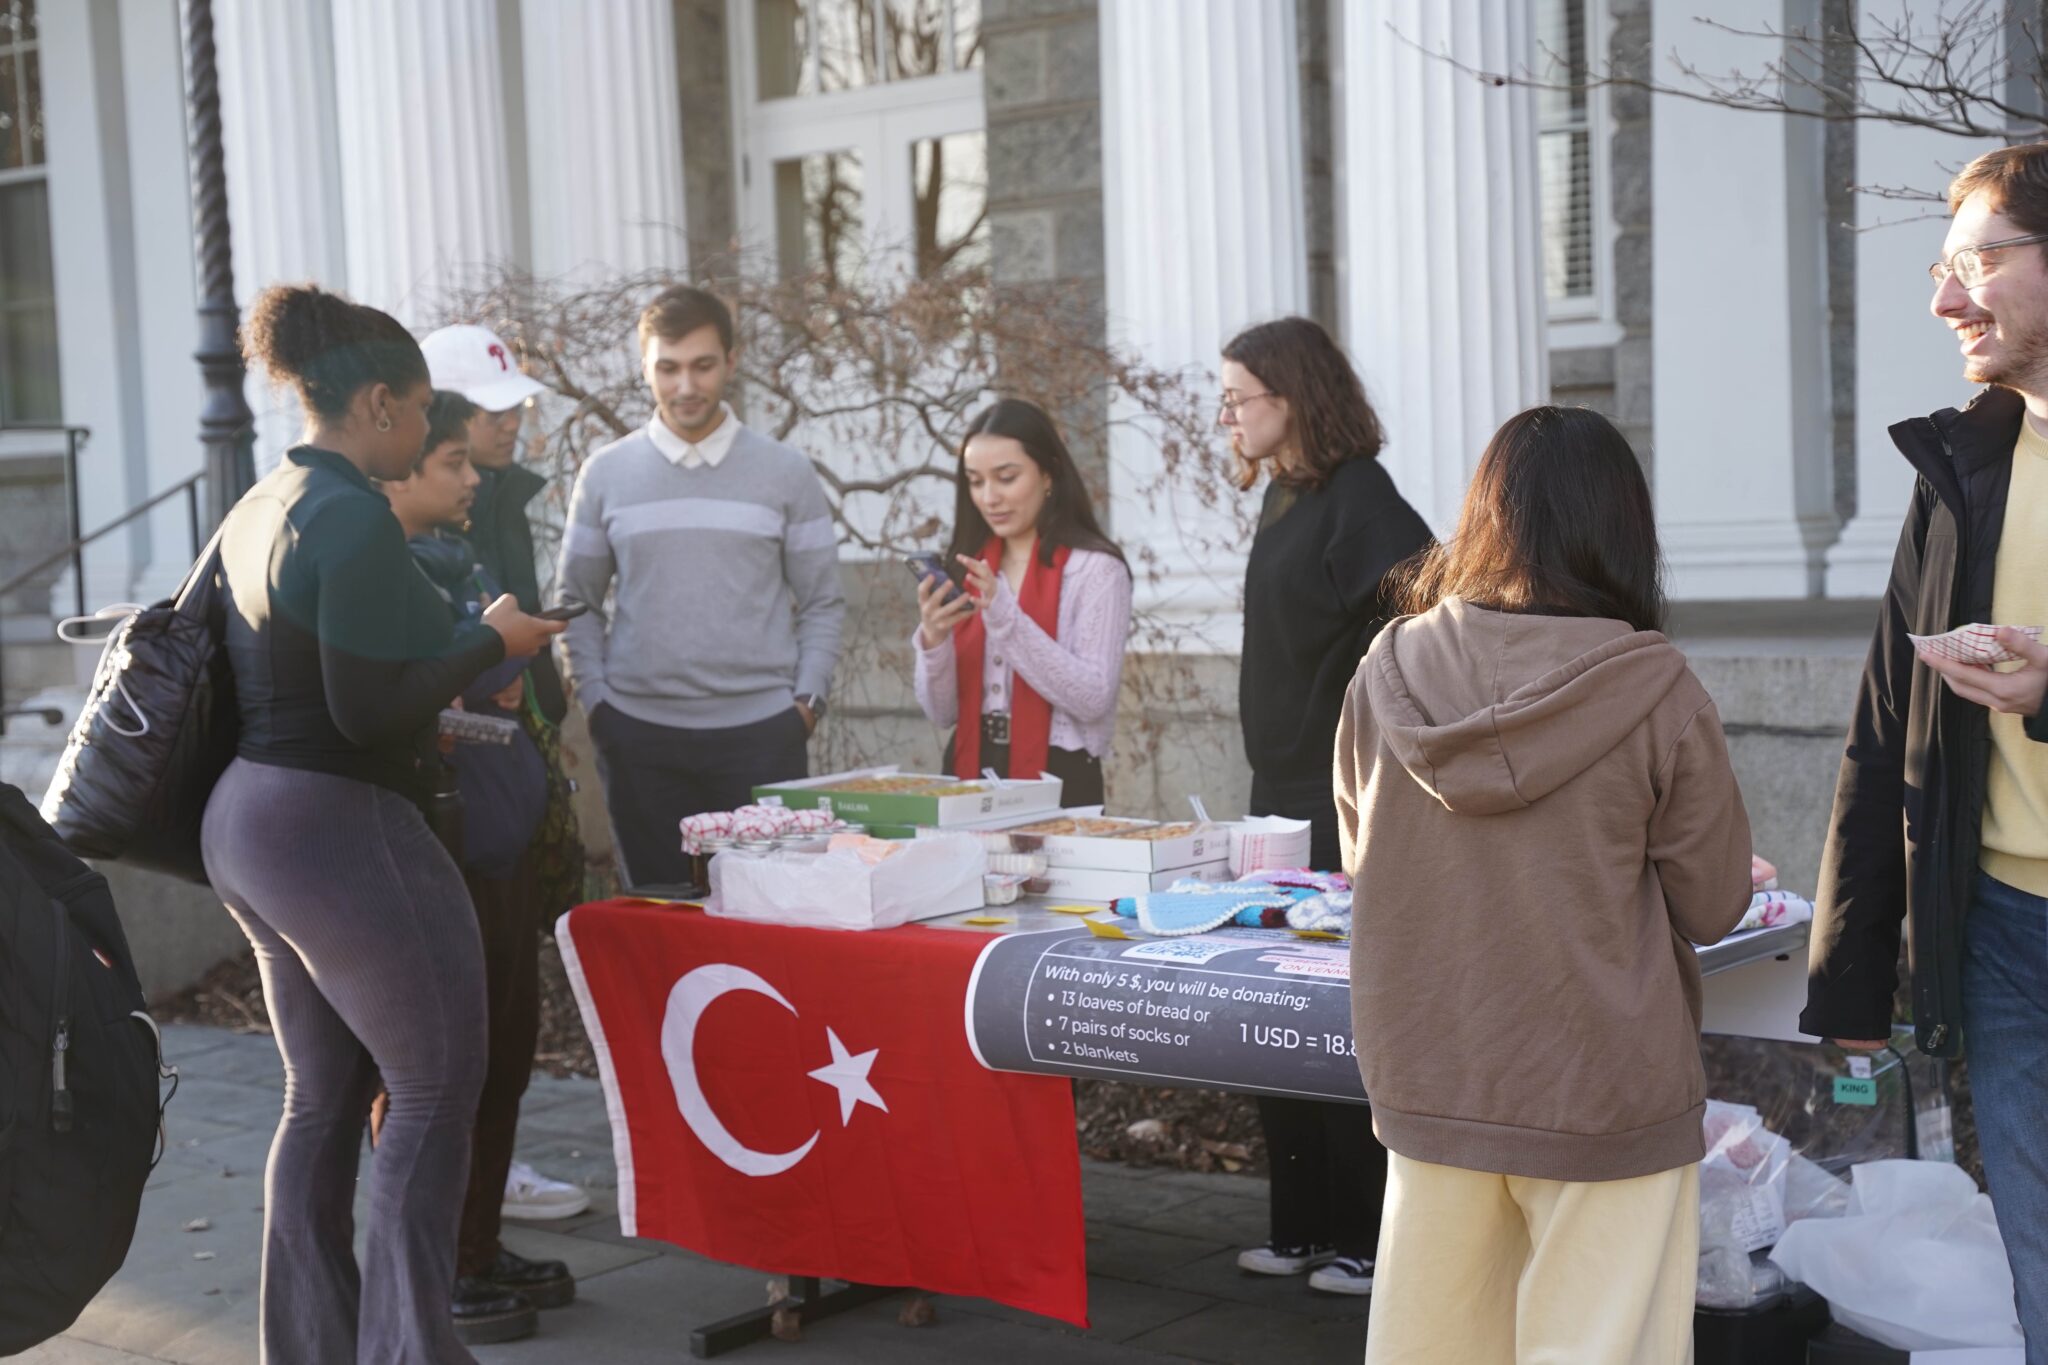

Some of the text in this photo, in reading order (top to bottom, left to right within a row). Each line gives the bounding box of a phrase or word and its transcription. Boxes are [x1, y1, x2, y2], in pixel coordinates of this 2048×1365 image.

[1045, 965, 1080, 981] With
[1082, 971, 1115, 989] only
[1116, 973, 1129, 987] 5
[1143, 979, 1175, 993] you
[1178, 981, 1207, 996] will
[1208, 983, 1229, 998] be
[1232, 986, 1311, 1011] donating:
[1062, 991, 1211, 1023] 13 loaves of bread or
[1058, 1015, 1190, 1047] 7 pairs of socks or
[1239, 1023, 1248, 1043] 1
[1254, 1024, 1300, 1049] USD
[1060, 1041, 1140, 1064] 2 blankets
[1841, 1083, 1869, 1094] KING
